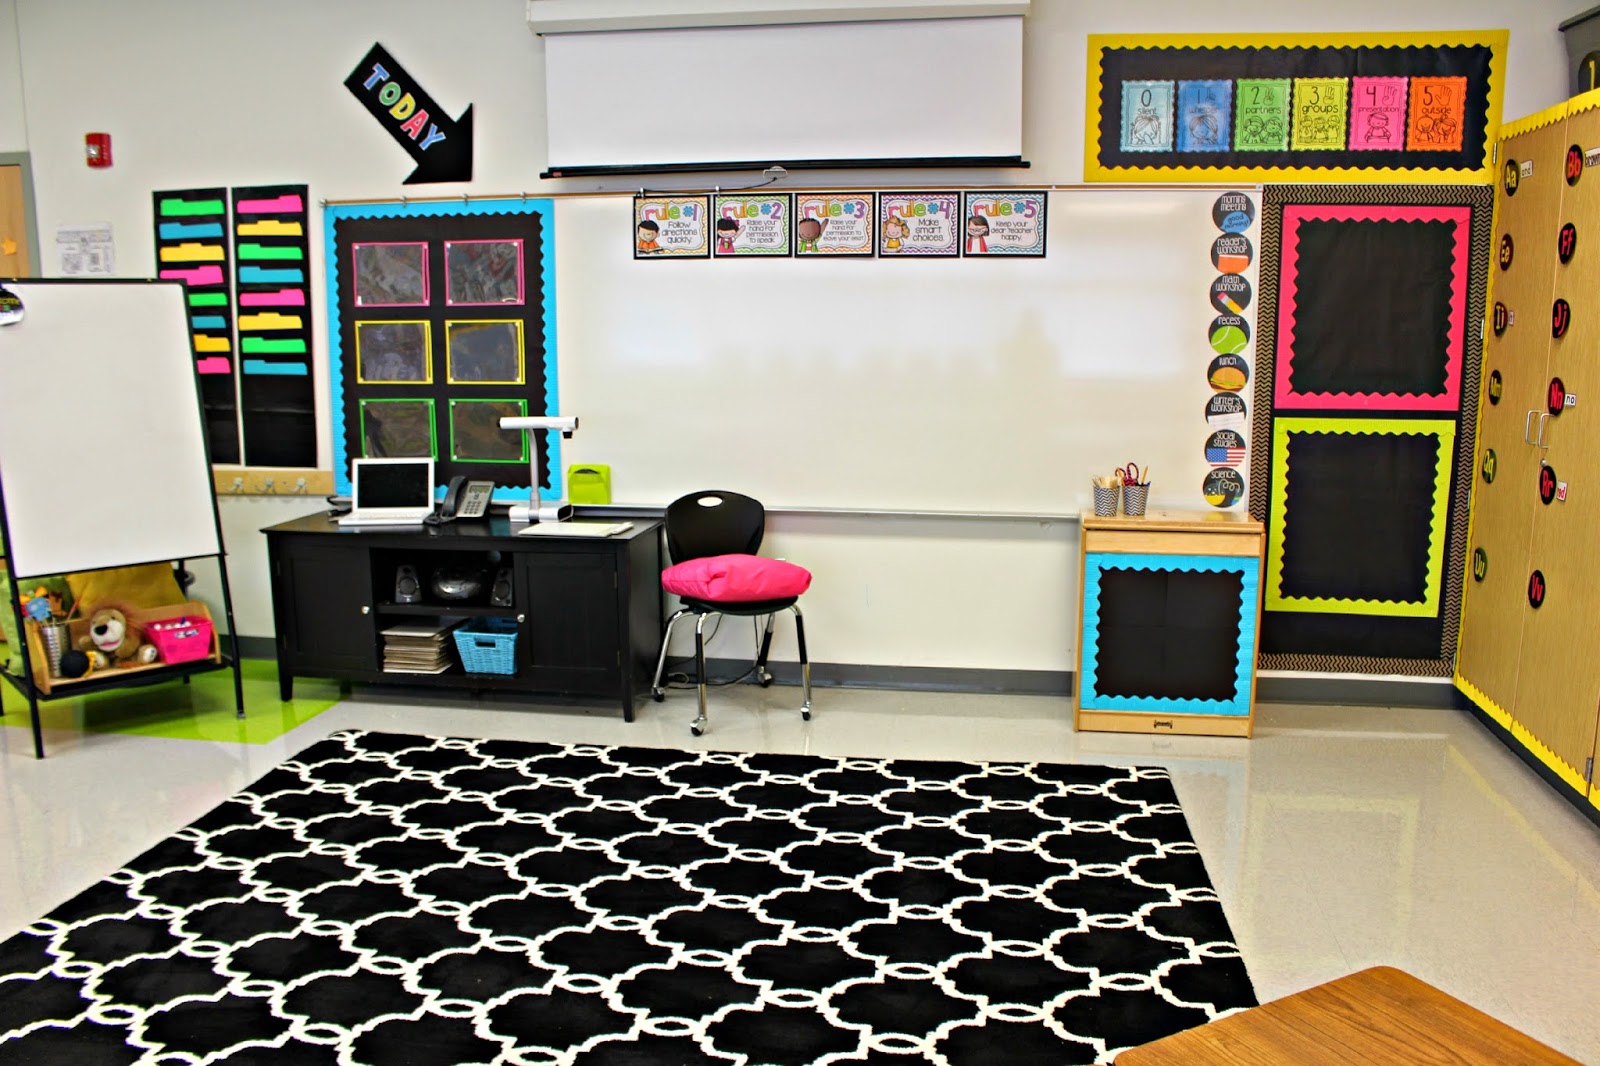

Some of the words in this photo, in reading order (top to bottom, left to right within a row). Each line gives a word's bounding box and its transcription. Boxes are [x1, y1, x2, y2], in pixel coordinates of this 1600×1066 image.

[1141, 89, 1151, 107] 0
[1251, 86, 1260, 105] 2
[1309, 86, 1320, 105] 3
[1366, 86, 1376, 106] 4
[1423, 86, 1433, 106] 5
[363, 62, 447, 151] TODAY
[1137, 107, 1157, 115] silent
[1245, 106, 1281, 115] partners
[1301, 104, 1339, 115] groups
[1421, 105, 1451, 115] outside
[1568, 151, 1581, 178] Bb
[1505, 164, 1517, 189] Aa
[1222, 195, 1246, 204] morning
[645, 202, 680, 220] rule
[683, 204, 698, 221] #1
[722, 200, 759, 220] rule
[761, 202, 782, 219] #2
[804, 199, 842, 220] rule
[843, 201, 865, 219] #3
[888, 200, 926, 219] rule
[928, 201, 951, 219] #4
[974, 199, 1012, 217] rule
[1014, 200, 1037, 218] #5
[1221, 203, 1247, 211] meeting
[918, 219, 940, 227] Make
[1228, 213, 1244, 225] good
[915, 226, 942, 234] smart
[1218, 237, 1247, 247] reader's
[1561, 228, 1574, 255] Ff
[1217, 244, 1248, 254] workshop
[1501, 240, 1510, 263] Ee
[1222, 275, 1240, 284] math
[1215, 282, 1246, 292] workshop
[1218, 316, 1241, 325] recess
[1554, 303, 1568, 335] Jj
[1219, 356, 1237, 366] lunch
[1213, 396, 1241, 406] writer's
[1550, 383, 1564, 410] Nn
[1566, 395, 1575, 404] no
[1210, 403, 1243, 413] workshop
[1216, 431, 1236, 441] social
[1213, 438, 1238, 448] studies
[1211, 470, 1236, 479] science
[1542, 470, 1553, 498] Rr
[1475, 553, 1485, 578] Uu
[1531, 575, 1543, 602] Vv
